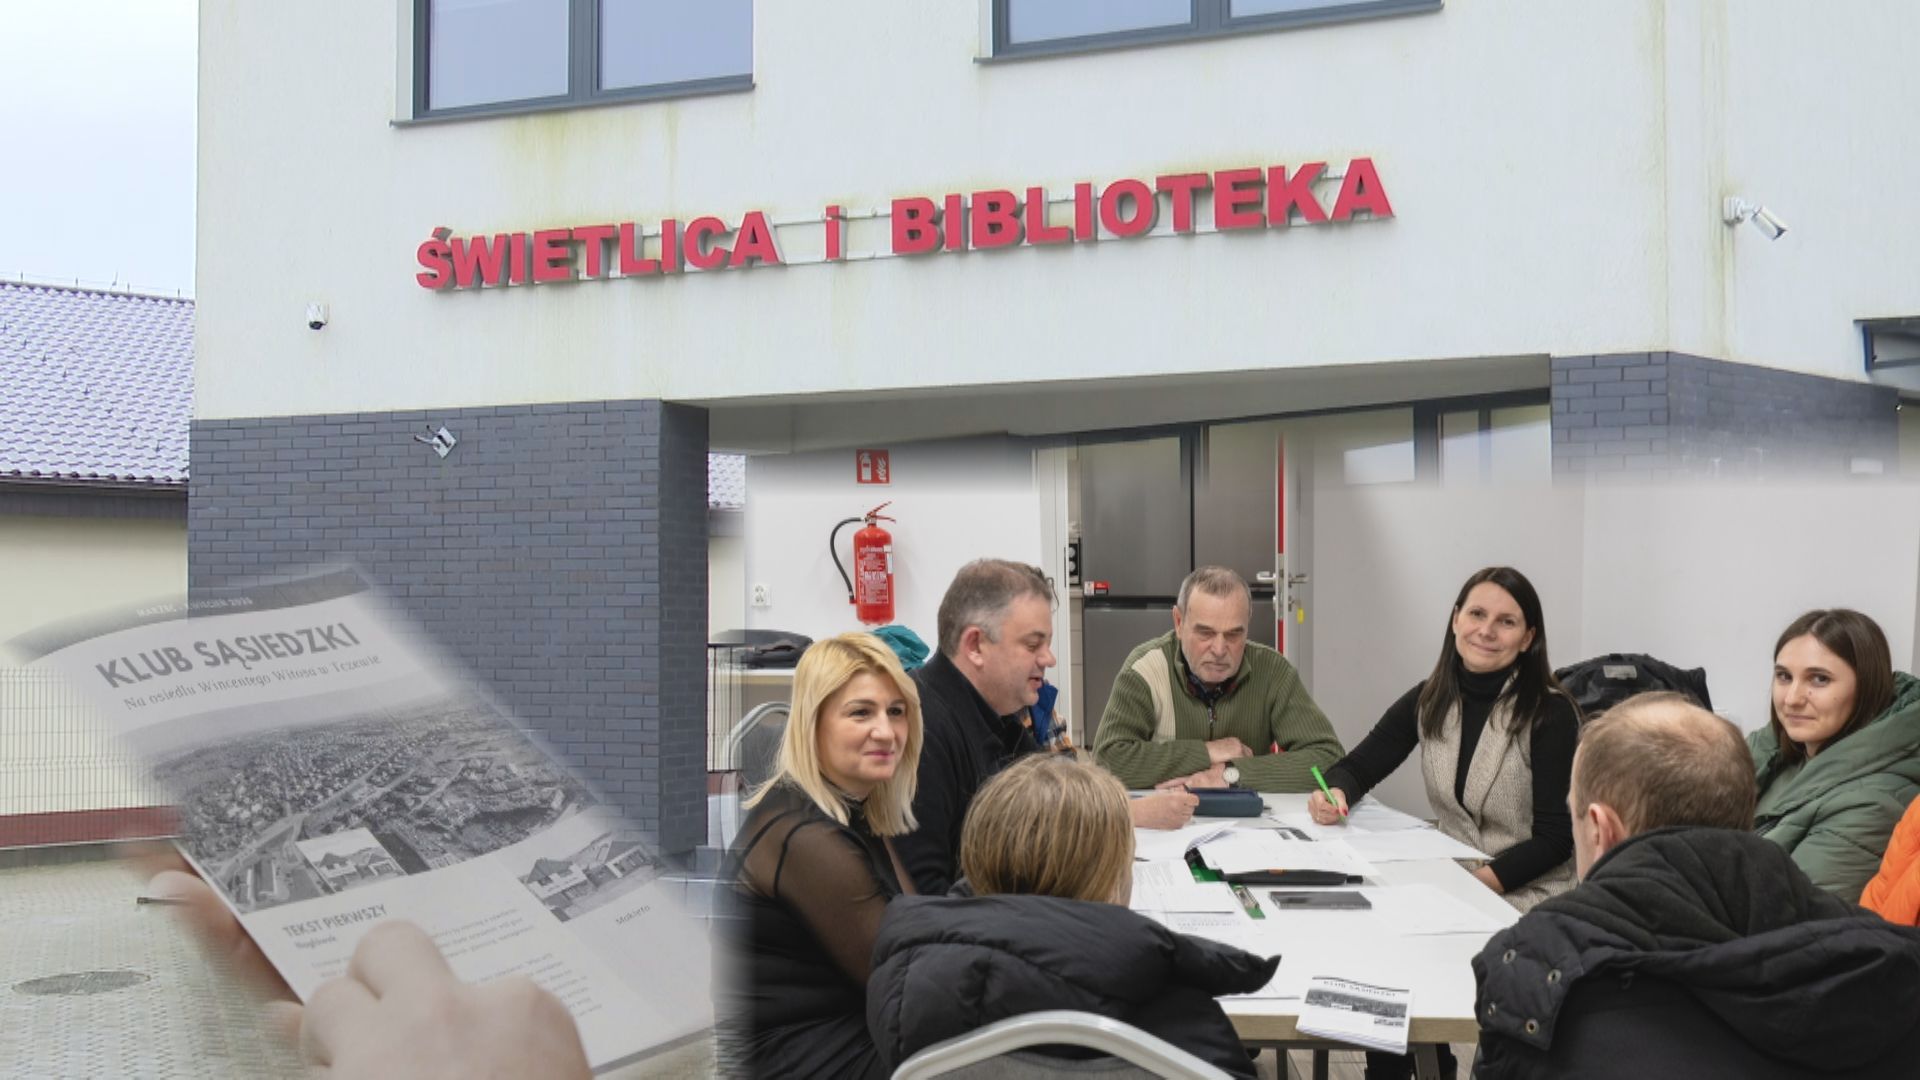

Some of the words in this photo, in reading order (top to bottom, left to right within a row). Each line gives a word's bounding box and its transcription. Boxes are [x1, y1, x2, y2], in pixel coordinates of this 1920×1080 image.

[416, 211, 780, 290] ŚWIETLICA
[825, 205, 845, 260] i
[891, 157, 1395, 255] BIBLIOTEKA
[95, 646, 193, 689] KLUB
[193, 622, 360, 671] SĄSIEDZKI
[123, 697, 147, 711] Na
[148, 680, 196, 704] osiedlu
[198, 672, 272, 694] Wincentego
[271, 667, 318, 684] Witosa
[319, 663, 330, 675] w
[331, 653, 382, 673] Tczewie
[282, 920, 323, 937] TEKST
[322, 903, 388, 930] PIERWSZY
